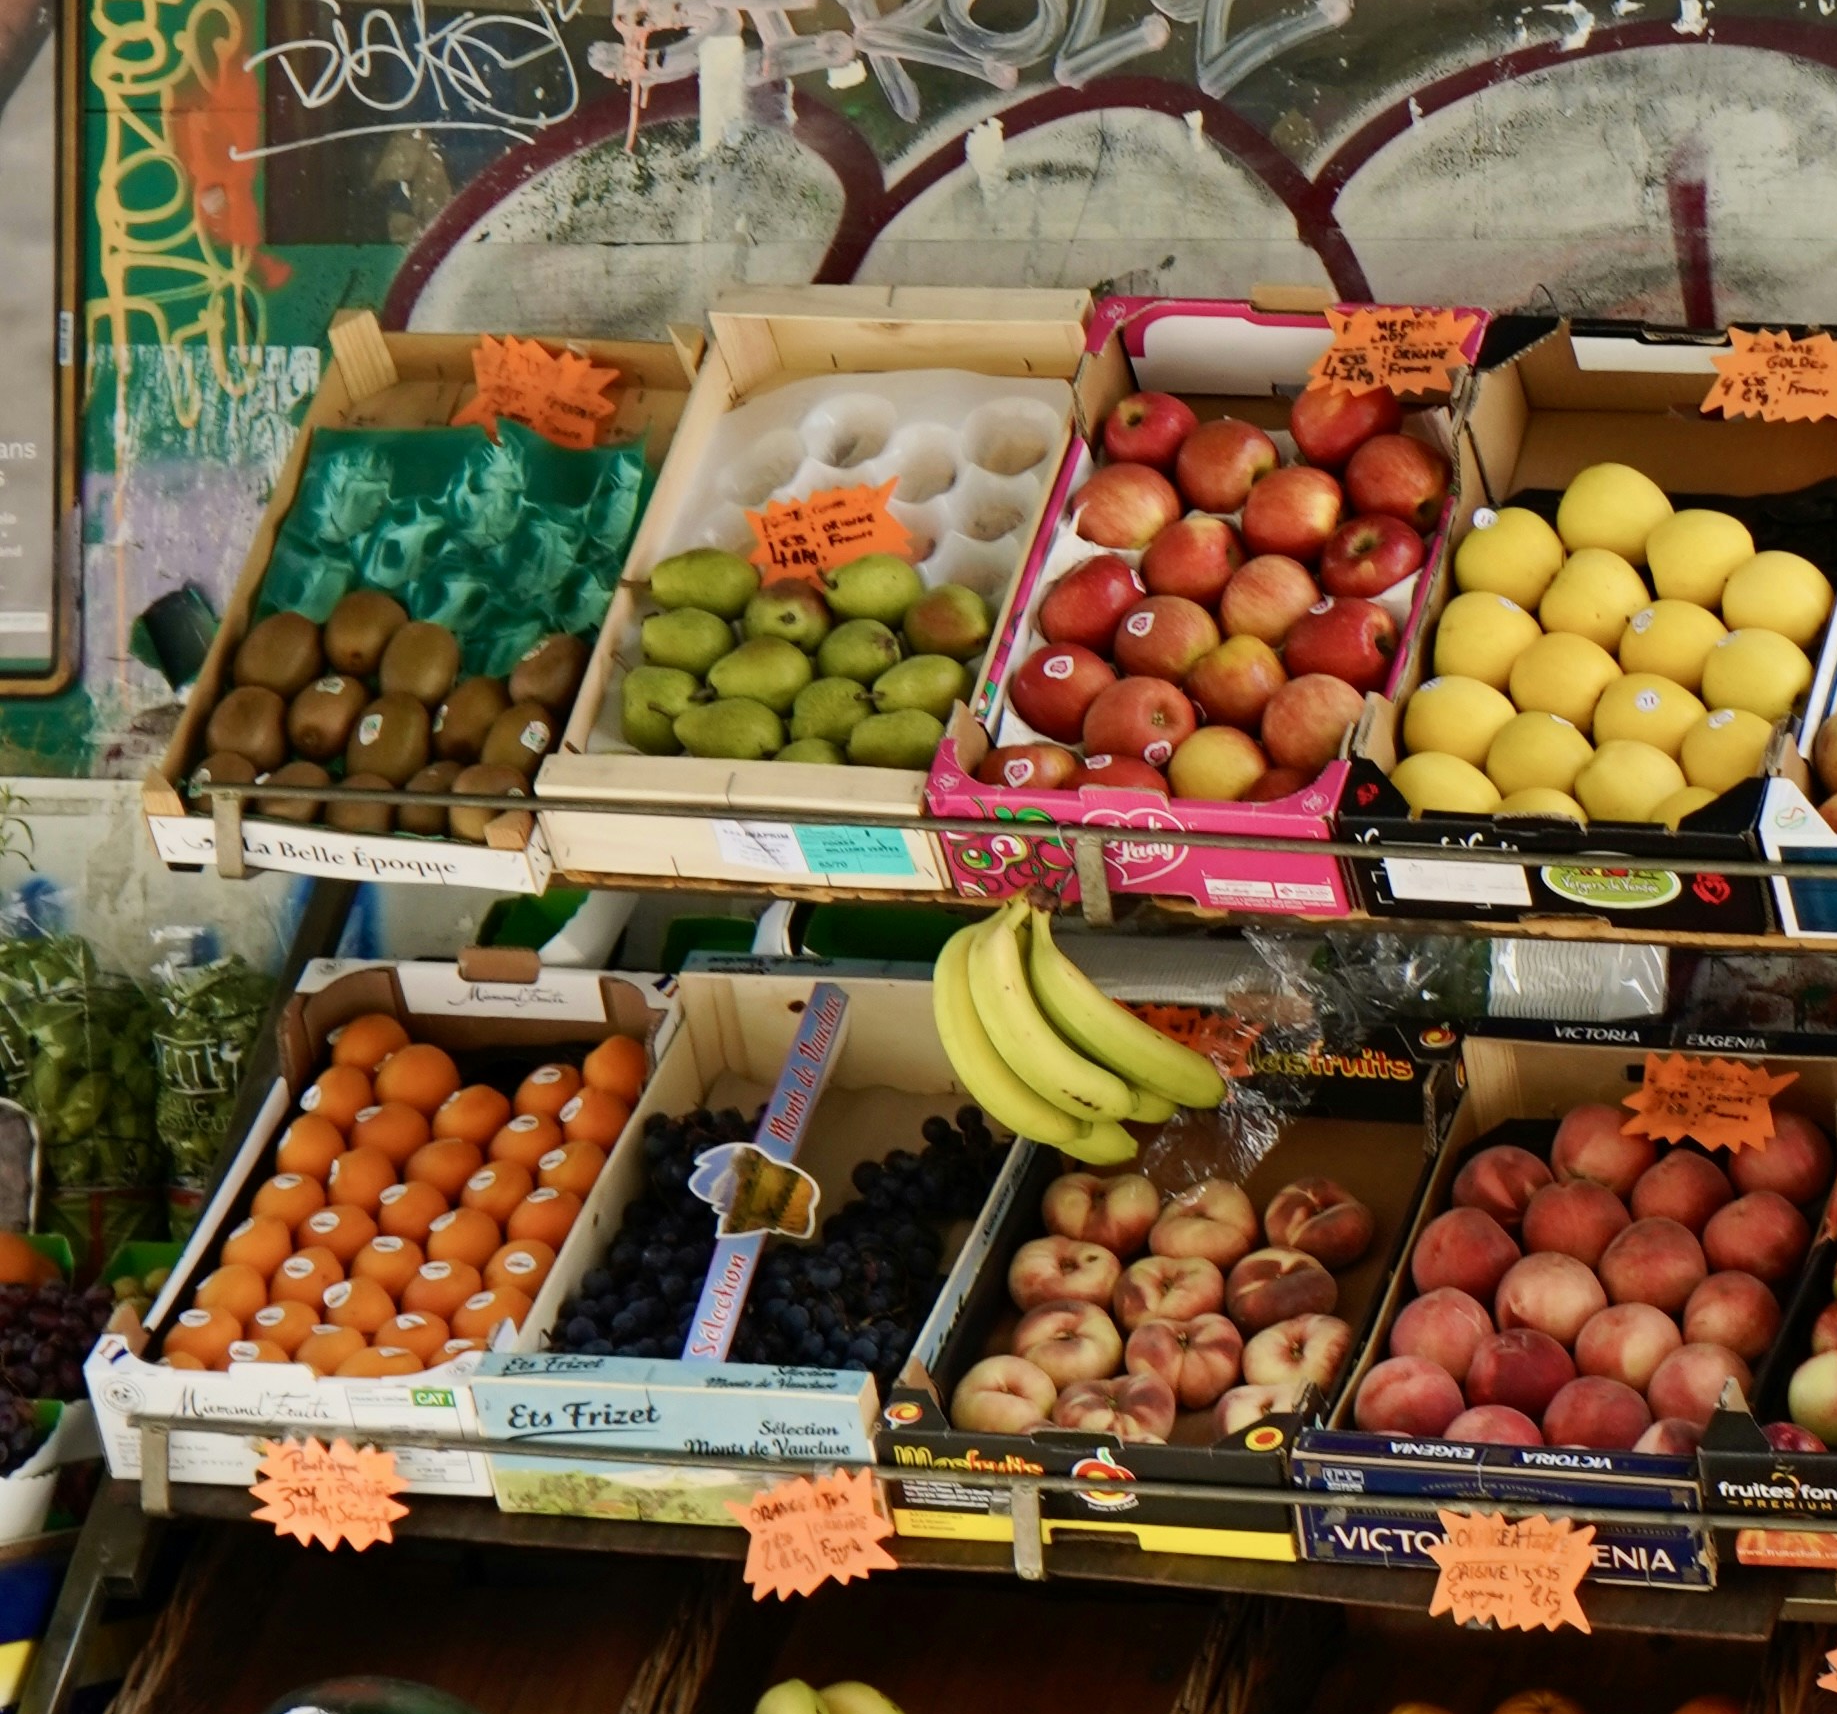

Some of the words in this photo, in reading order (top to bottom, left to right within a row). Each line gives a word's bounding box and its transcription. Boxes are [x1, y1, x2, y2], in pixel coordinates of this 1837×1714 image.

[1370, 332, 1408, 344] LADY
[1392, 348, 1448, 360] ORIGINE
[243, 837, 272, 855] La
[278, 841, 345, 867] Belle
[351, 846, 460, 878] Époque
[1554, 1025, 1641, 1044] VICTORIA
[1686, 1033, 1768, 1051] EUGENIA
[767, 1089, 810, 1143] Monts
[798, 993, 843, 1064] Vaucluse
[690, 1250, 750, 1359] Sélection
[546, 1356, 605, 1372] Frizet
[415, 1392, 446, 1405] CAT
[507, 1403, 552, 1429] Ets
[562, 1401, 661, 1428] Frizet
[758, 1421, 840, 1437] Sélection
[684, 1438, 745, 1456] Monts
[749, 1439, 770, 1456] de
[772, 1438, 851, 1457] Vaucluse
[1390, 1440, 1477, 1460] EUGENIA
[1521, 1451, 1613, 1470] VICTORIA
[1717, 1480, 1795, 1499] fruites
[1743, 1498, 1832, 1511] PREMIUM
[1334, 1525, 1450, 1557] VICTO
[1592, 1544, 1677, 1573] ENIA
[1447, 1565, 1509, 1582] ORIGINE
